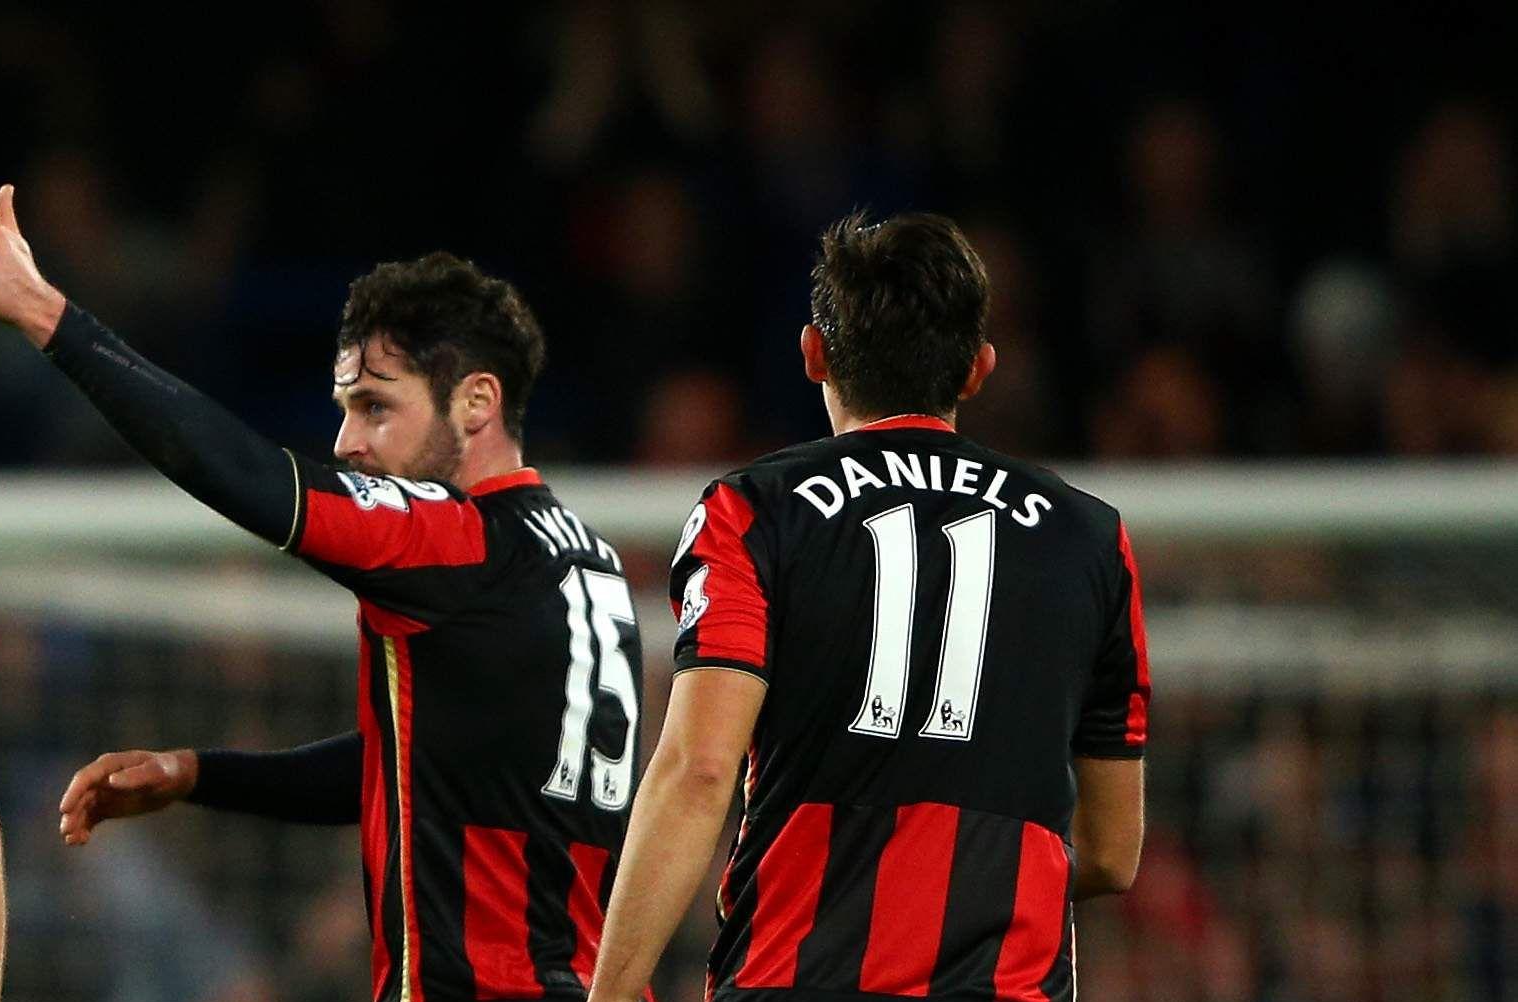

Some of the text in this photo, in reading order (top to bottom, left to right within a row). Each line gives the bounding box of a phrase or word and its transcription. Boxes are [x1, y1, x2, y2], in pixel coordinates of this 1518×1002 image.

[793, 450, 1053, 528] DANIELS
[540, 565, 635, 811] 15
[848, 502, 995, 741] 11
